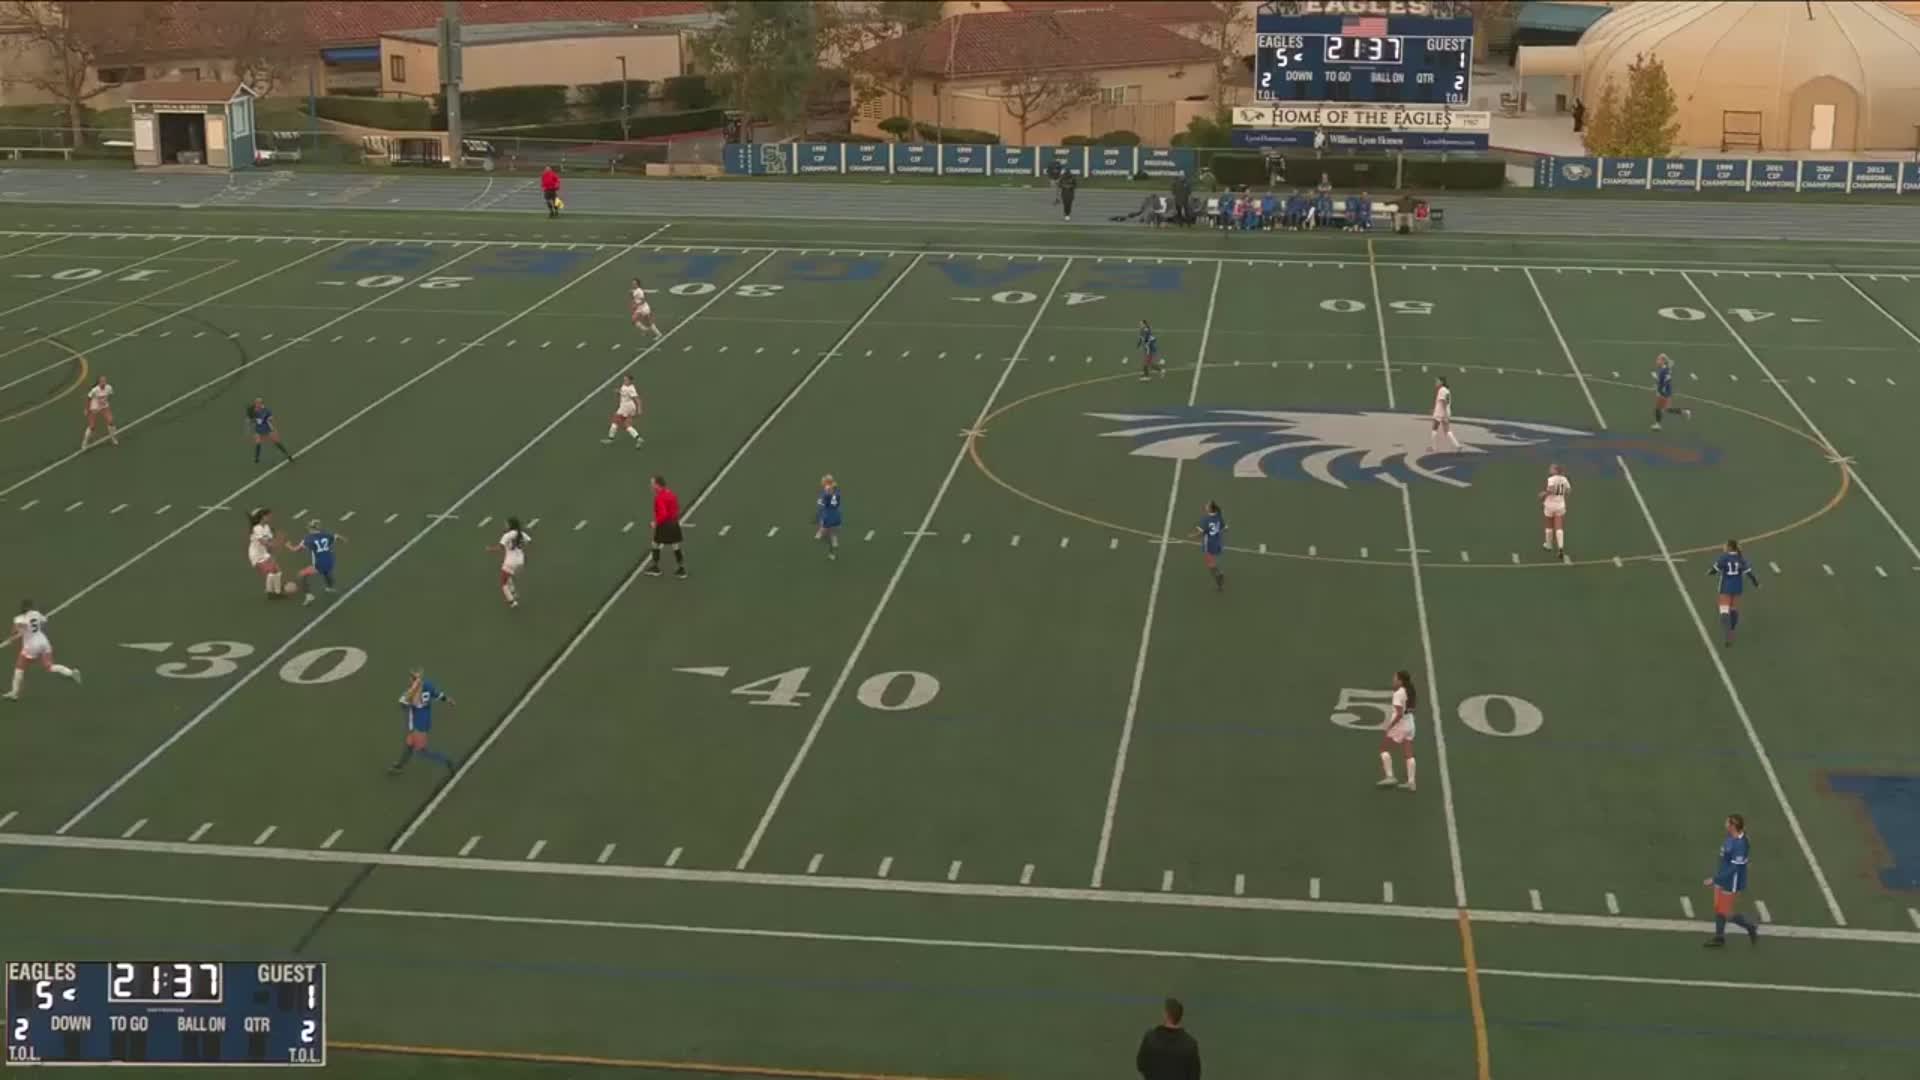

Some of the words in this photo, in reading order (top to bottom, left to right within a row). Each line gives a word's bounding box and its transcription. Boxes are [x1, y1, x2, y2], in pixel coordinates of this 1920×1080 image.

[1306, 0, 1427, 13] EAGLES
[1258, 36, 1304, 49] EAGLES
[1327, 37, 1401, 60] 21:37
[1426, 38, 1466, 51] GUEST
[1276, 48, 1288, 67] 5
[1261, 72, 1272, 87] 2
[1286, 71, 1313, 82] DOWN
[1325, 71, 1337, 82] TO
[1338, 72, 1351, 82] GO
[1371, 72, 1392, 83] BALL
[1392, 73, 1405, 83] ON
[1416, 72, 1435, 84] QTR
[1454, 75, 1464, 90] 2
[1273, 110, 1321, 124] HOME
[1327, 110, 1351, 125] OF
[1355, 111, 1388, 125] THE
[1394, 111, 1452, 126] EAGLES
[1329, 134, 1357, 145] William
[314, 537, 330, 553] 12
[1727, 561, 1739, 576] 11
